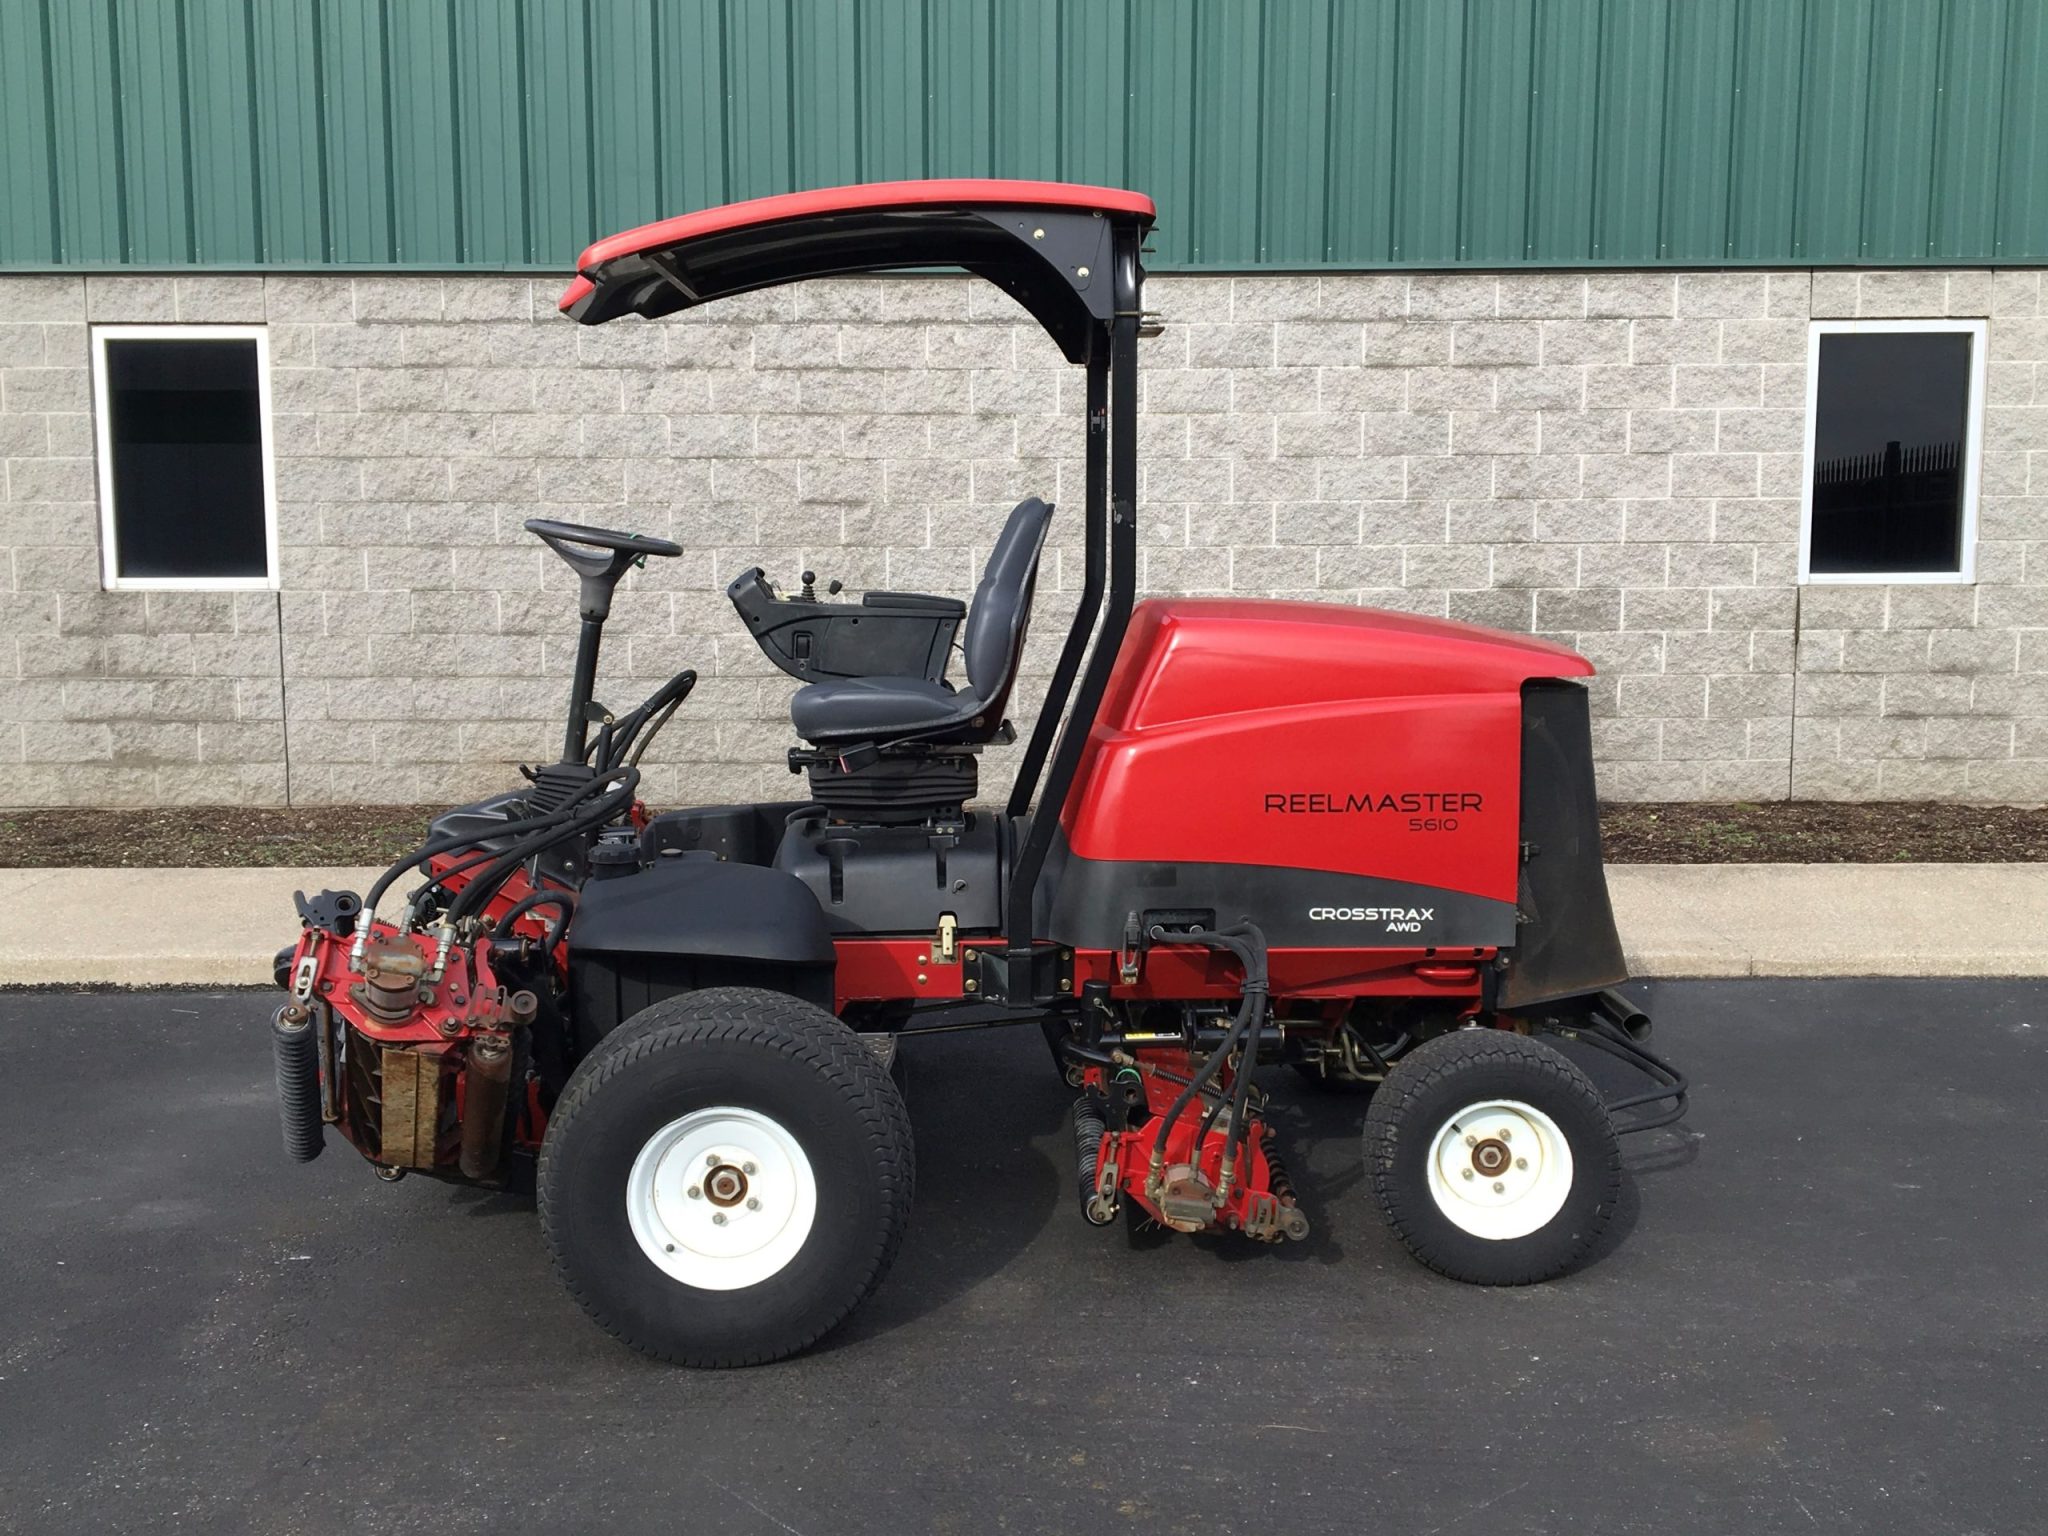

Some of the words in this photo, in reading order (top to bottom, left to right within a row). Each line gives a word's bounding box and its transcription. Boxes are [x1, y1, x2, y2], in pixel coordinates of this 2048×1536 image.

[1264, 793, 1483, 813] REELMASTER
[1408, 818, 1459, 831] 5610
[1308, 908, 1435, 921] CROSSTRAX
[1385, 922, 1422, 932] AWD
